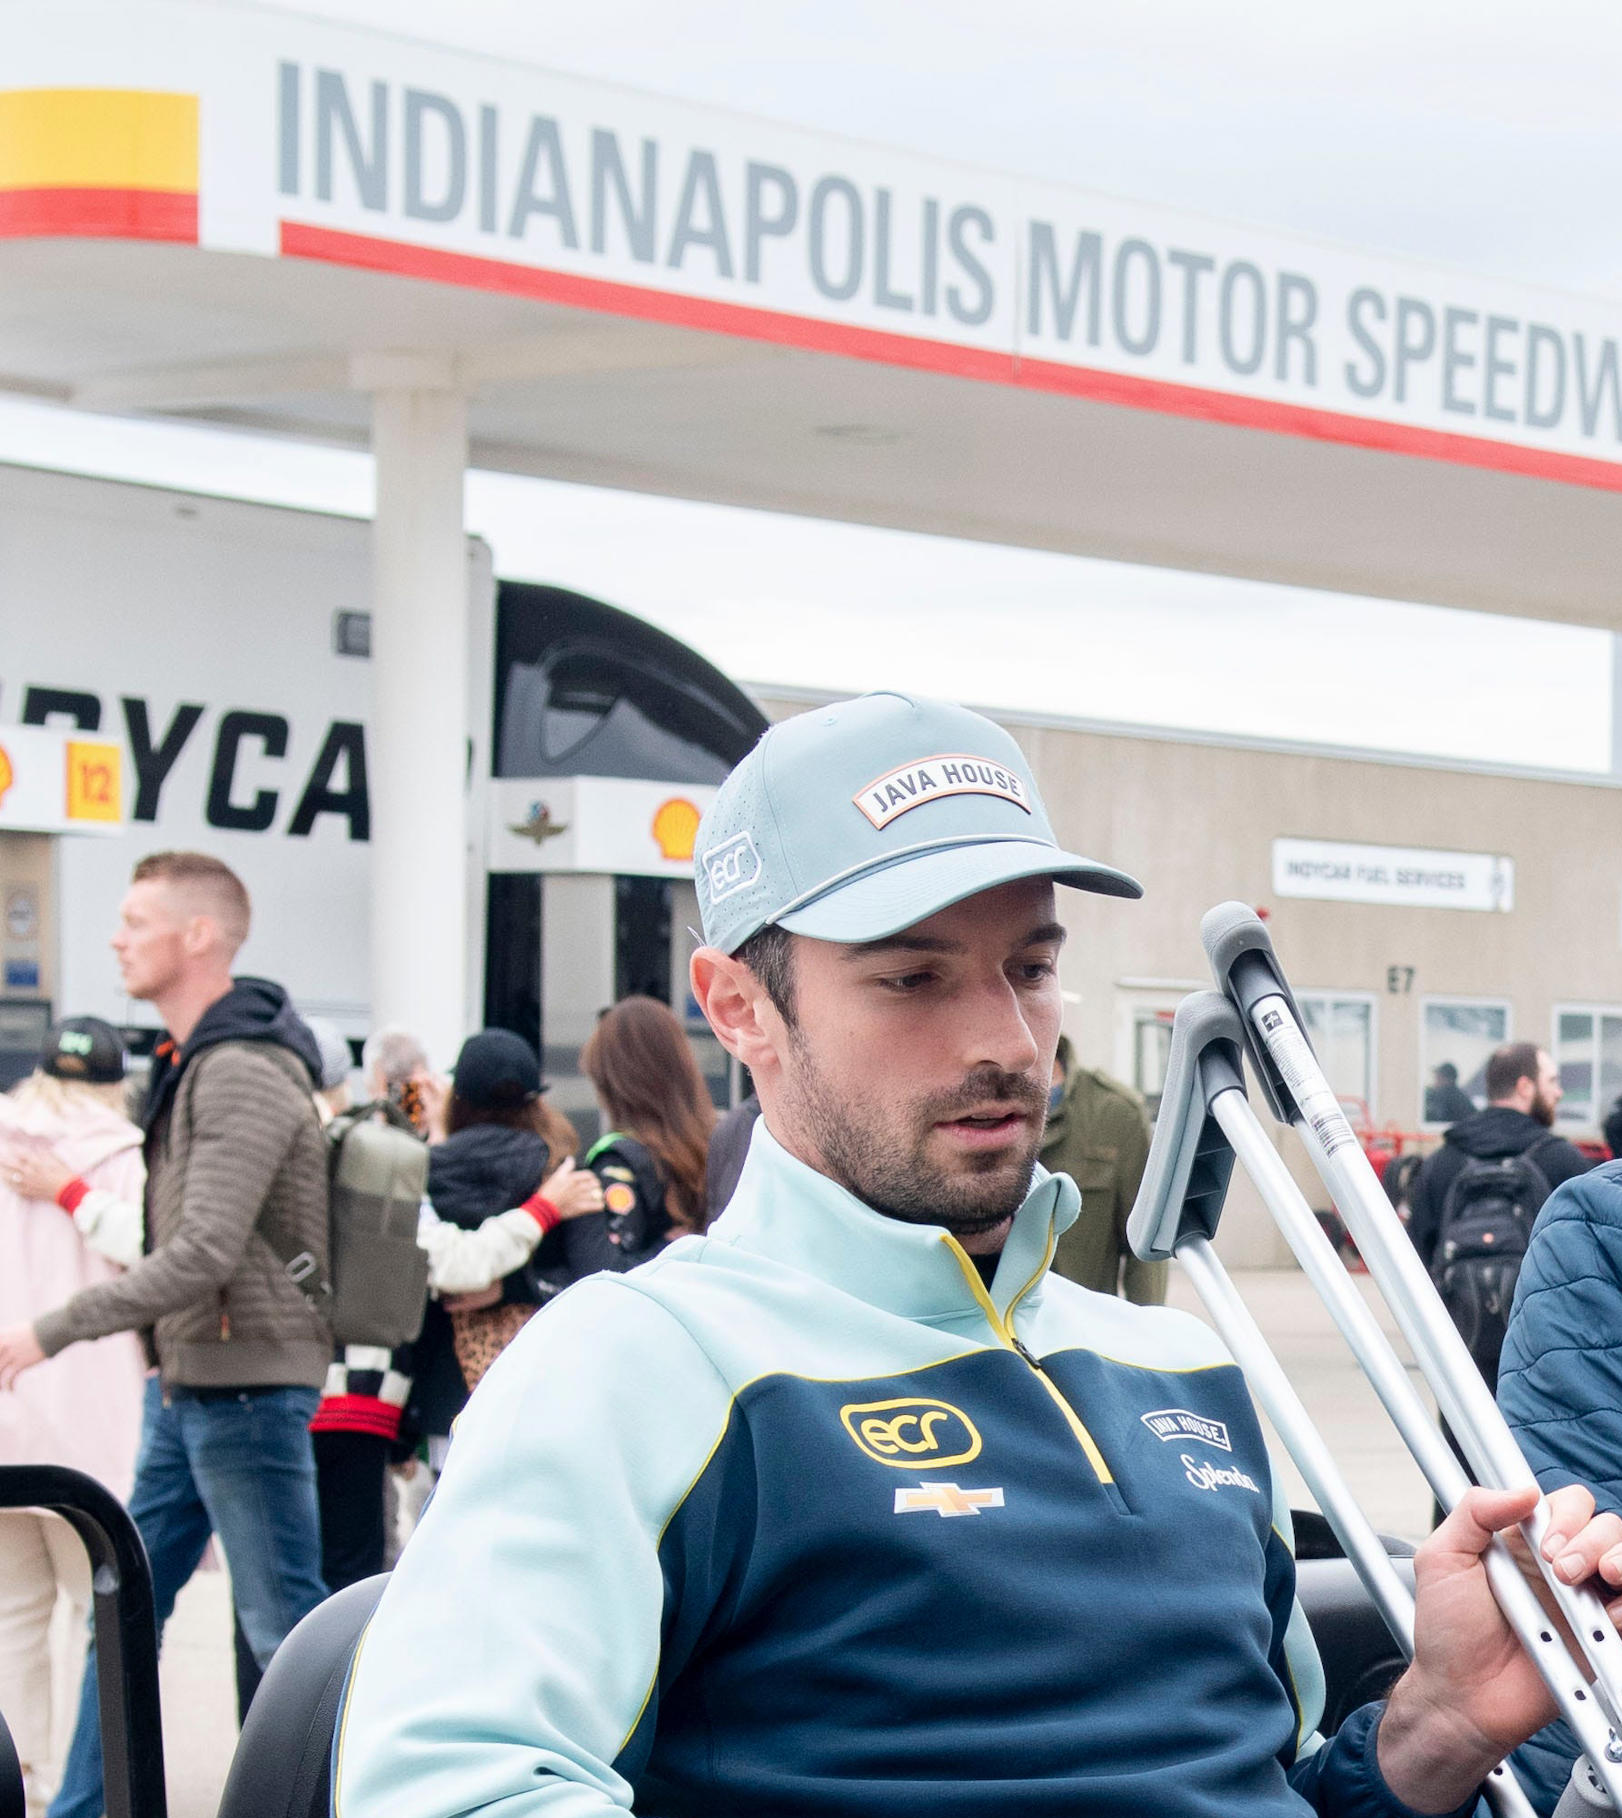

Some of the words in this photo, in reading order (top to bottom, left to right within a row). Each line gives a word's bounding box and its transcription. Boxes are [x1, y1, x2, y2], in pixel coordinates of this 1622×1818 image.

[278, 60, 996, 326] INDIANAPOLIS
[1026, 221, 1318, 388] MOTOR
[22, 686, 472, 842] YCA
[81, 762, 111, 803] 12
[872, 769, 937, 813] JAVA
[941, 763, 1021, 797] HOUSE
[710, 846, 746, 889] ecr
[1285, 860, 1350, 881] INDYCAR
[1357, 867, 1389, 885] FUEL
[1396, 870, 1466, 890] SERVICES
[1387, 966, 1416, 993] E7
[860, 1409, 948, 1455] ecr
[1150, 1415, 1180, 1435] JAVA
